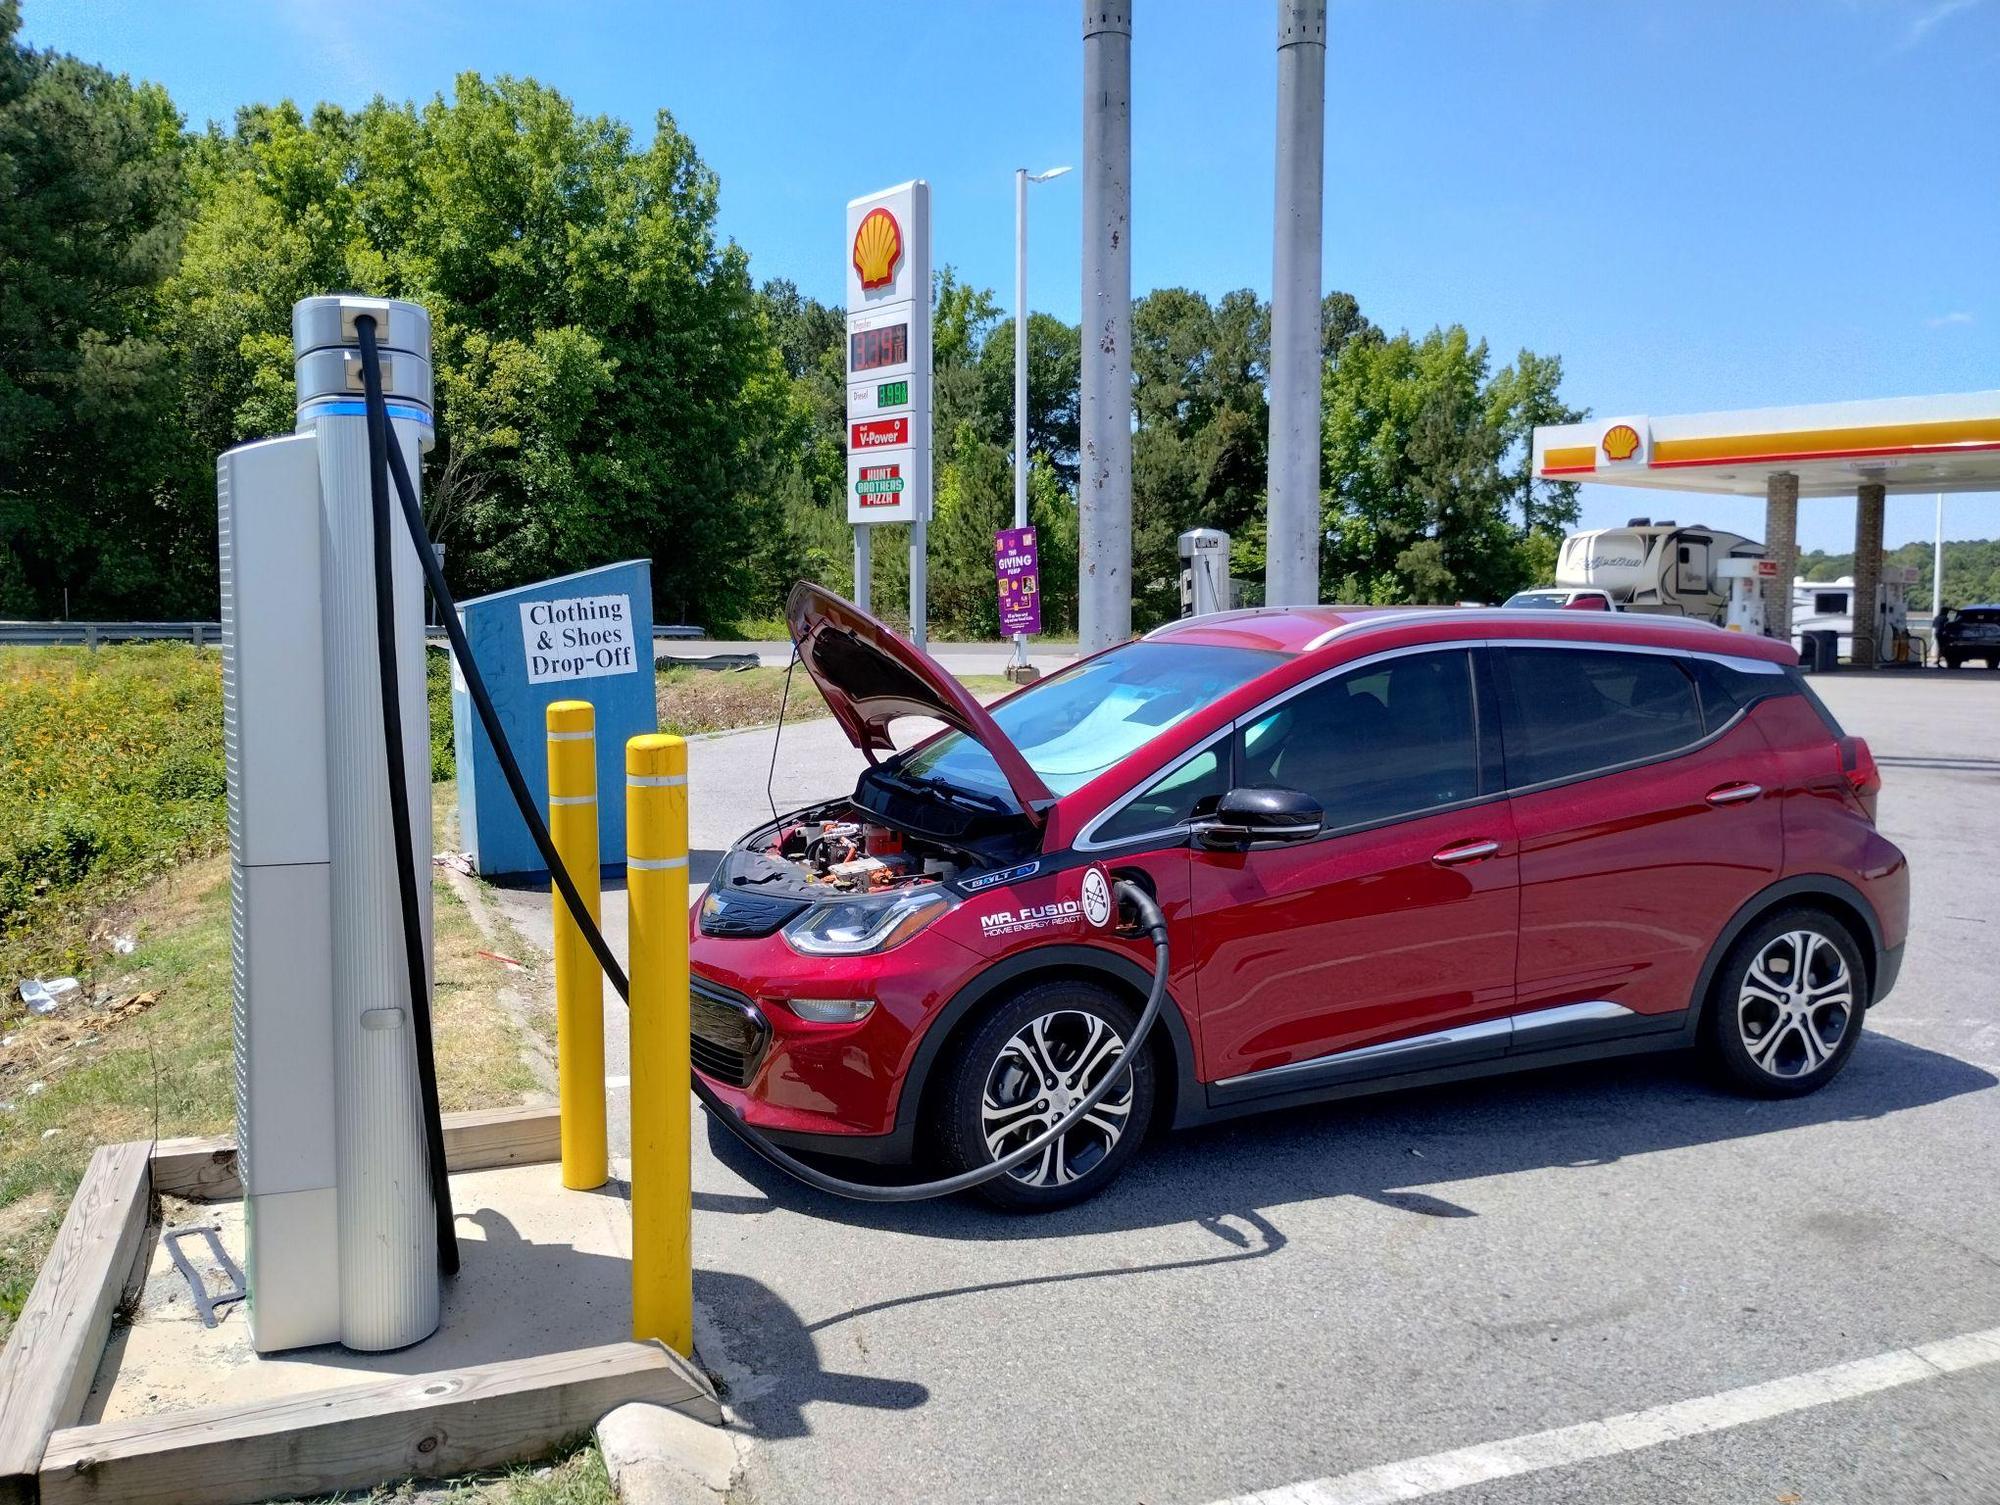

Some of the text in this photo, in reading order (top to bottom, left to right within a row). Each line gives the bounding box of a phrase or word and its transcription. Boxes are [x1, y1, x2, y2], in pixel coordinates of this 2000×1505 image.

[853, 389, 869, 401] Diesel
[859, 432, 898, 446] V-Power
[867, 467, 891, 481] HUNT
[857, 479, 903, 494] BROTHERS
[867, 492, 893, 505] PIZZA
[998, 555, 1032, 569] GIVING
[530, 601, 622, 625] Clothing
[536, 627, 622, 651] & Shoes
[532, 646, 631, 676] Drop-Off
[1016, 864, 1034, 876] EV
[981, 912, 1017, 928] MR.
[984, 915, 1083, 938] HOME ENERGY REACT
